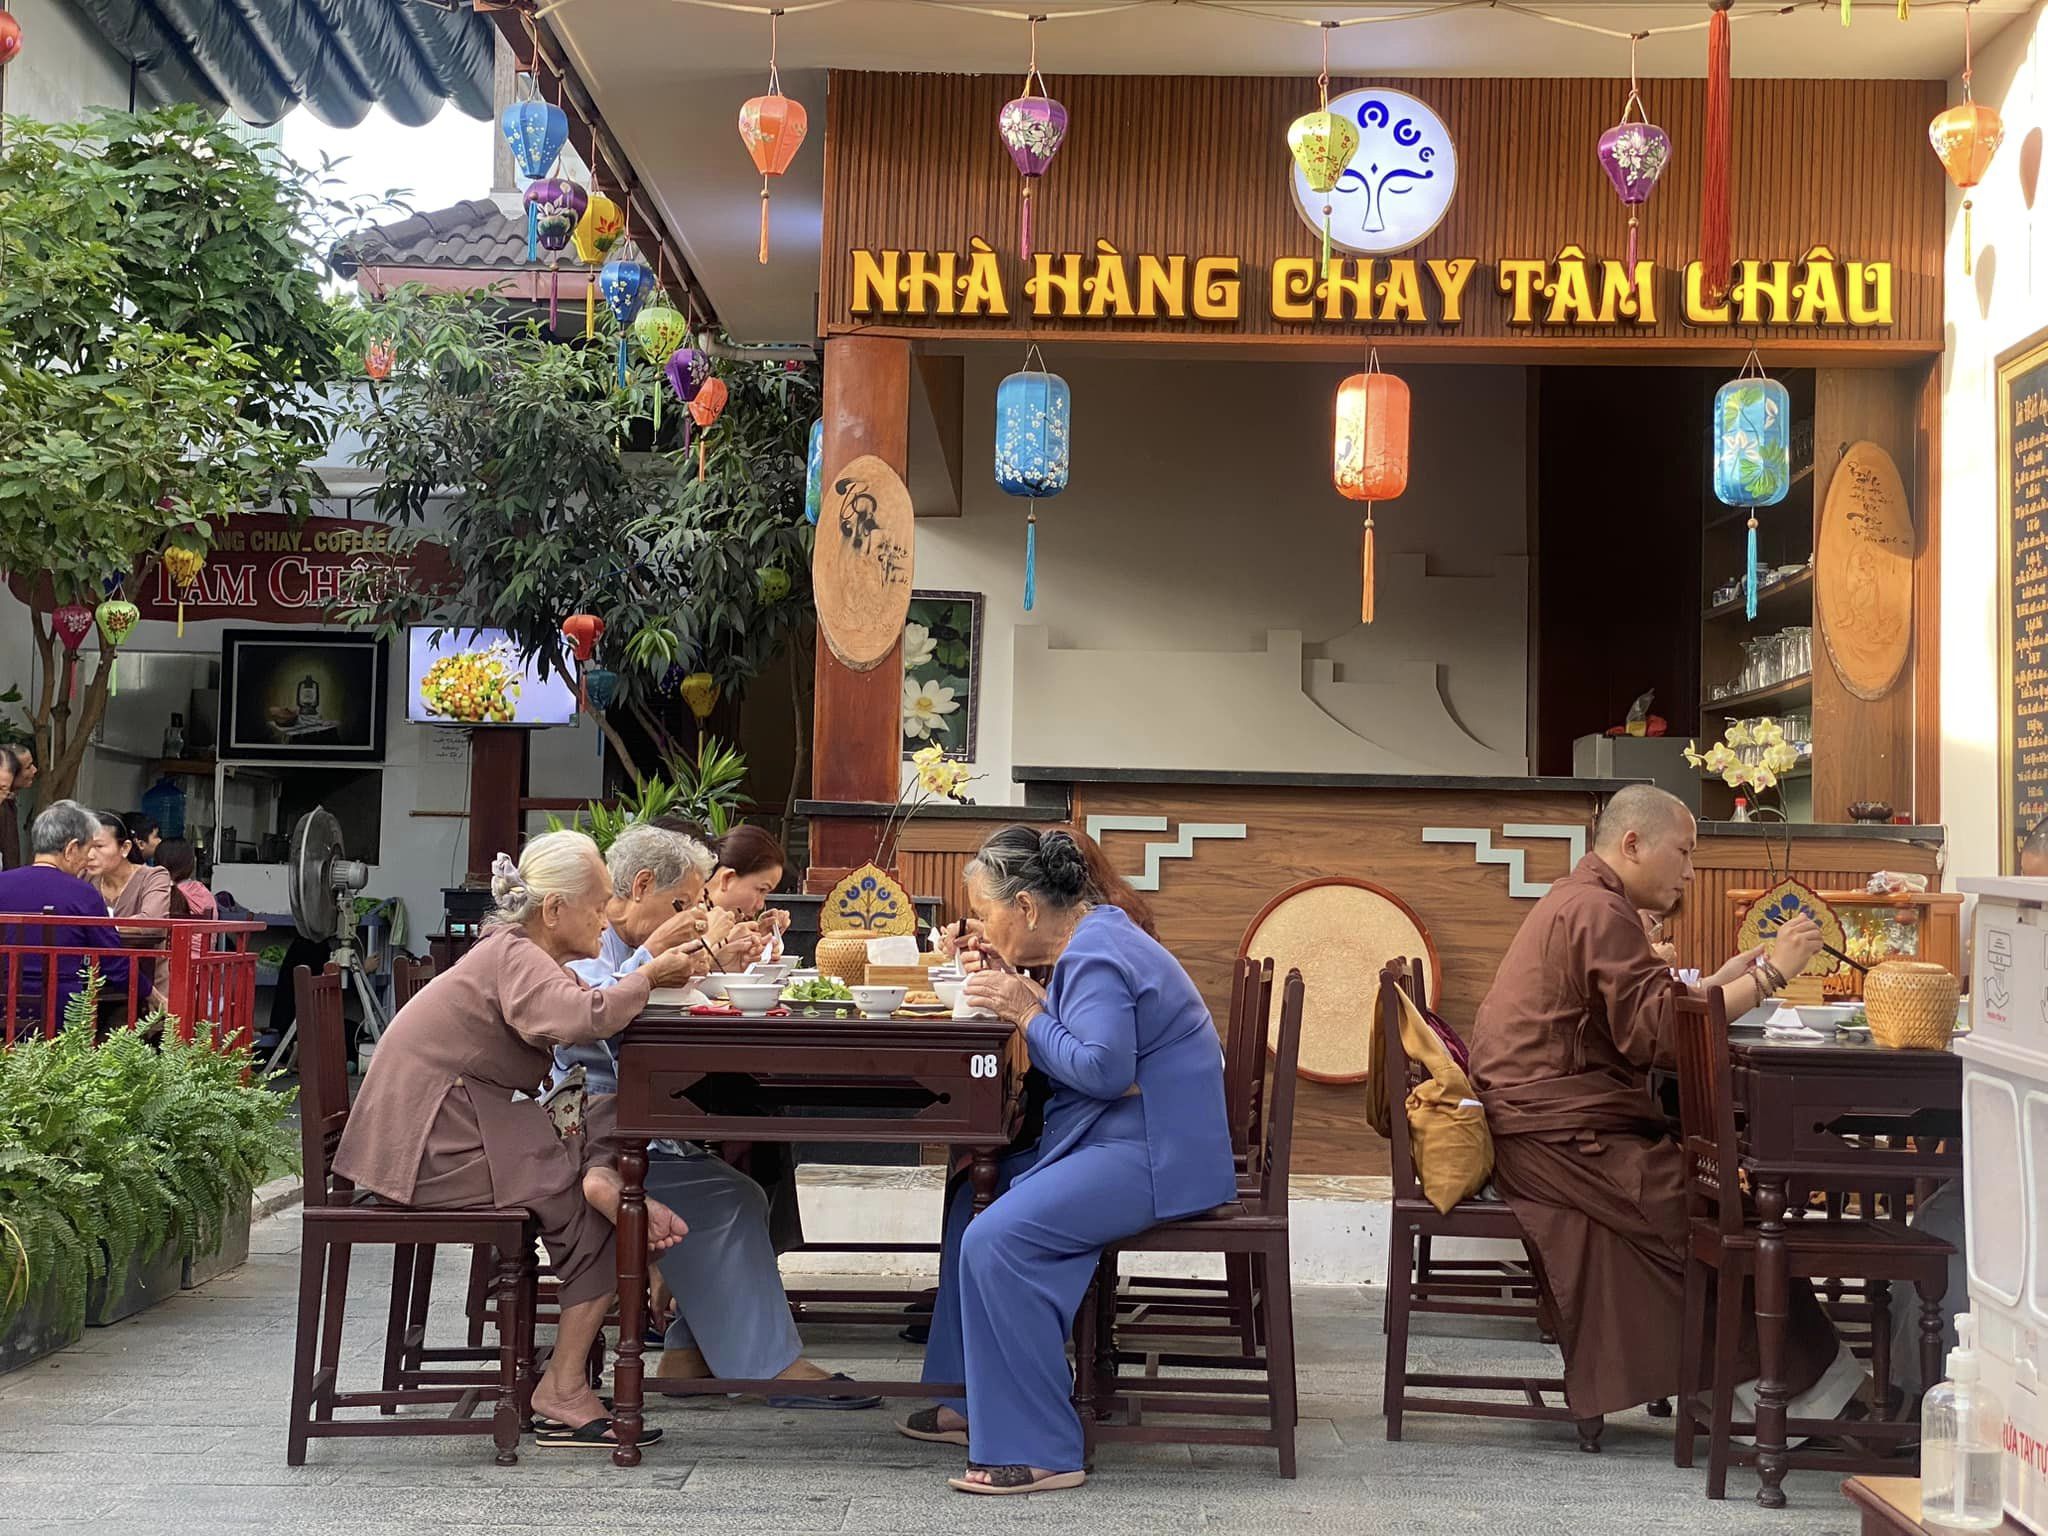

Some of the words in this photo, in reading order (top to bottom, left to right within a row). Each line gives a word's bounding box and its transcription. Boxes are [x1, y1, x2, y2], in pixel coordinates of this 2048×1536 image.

[851, 235, 1009, 314] NHÀ
[1025, 239, 1240, 318] HÀNG
[1272, 258, 1478, 321] CHAY
[1500, 245, 1656, 323] TÂM
[1685, 245, 1893, 324] CHÂU
[970, 1054, 998, 1079] 08
[2019, 1431, 2035, 1466] TAY
